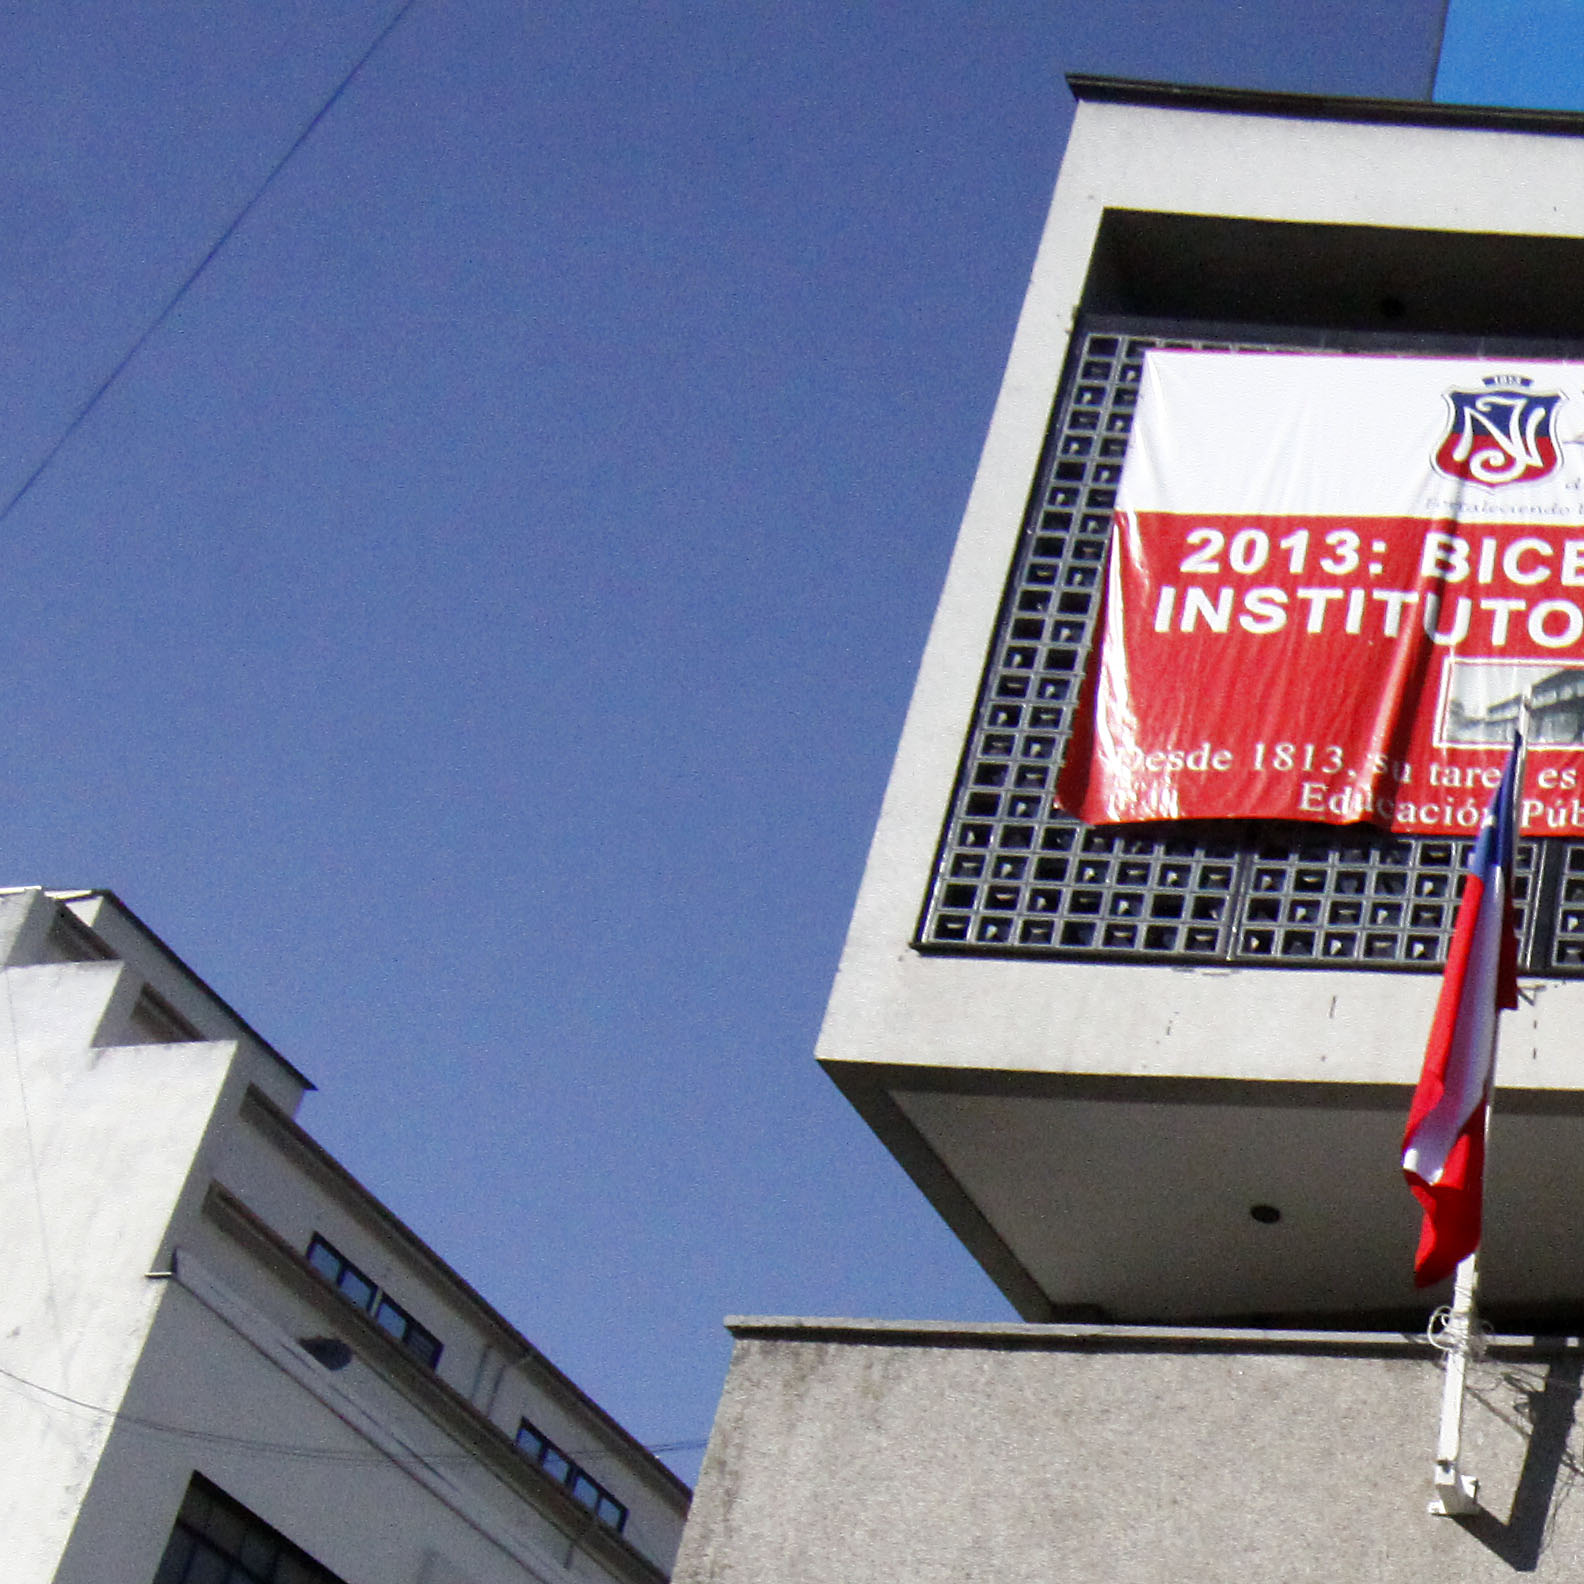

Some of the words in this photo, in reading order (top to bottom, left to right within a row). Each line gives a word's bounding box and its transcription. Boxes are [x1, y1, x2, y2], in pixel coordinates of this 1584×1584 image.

[1180, 527, 1388, 577] 2013:
[1117, 742, 1233, 772] Desde
[1253, 742, 1357, 780] 1813,
[1368, 750, 1411, 785] su
[1430, 761, 1503, 789] tare
[1537, 767, 1577, 790] es
